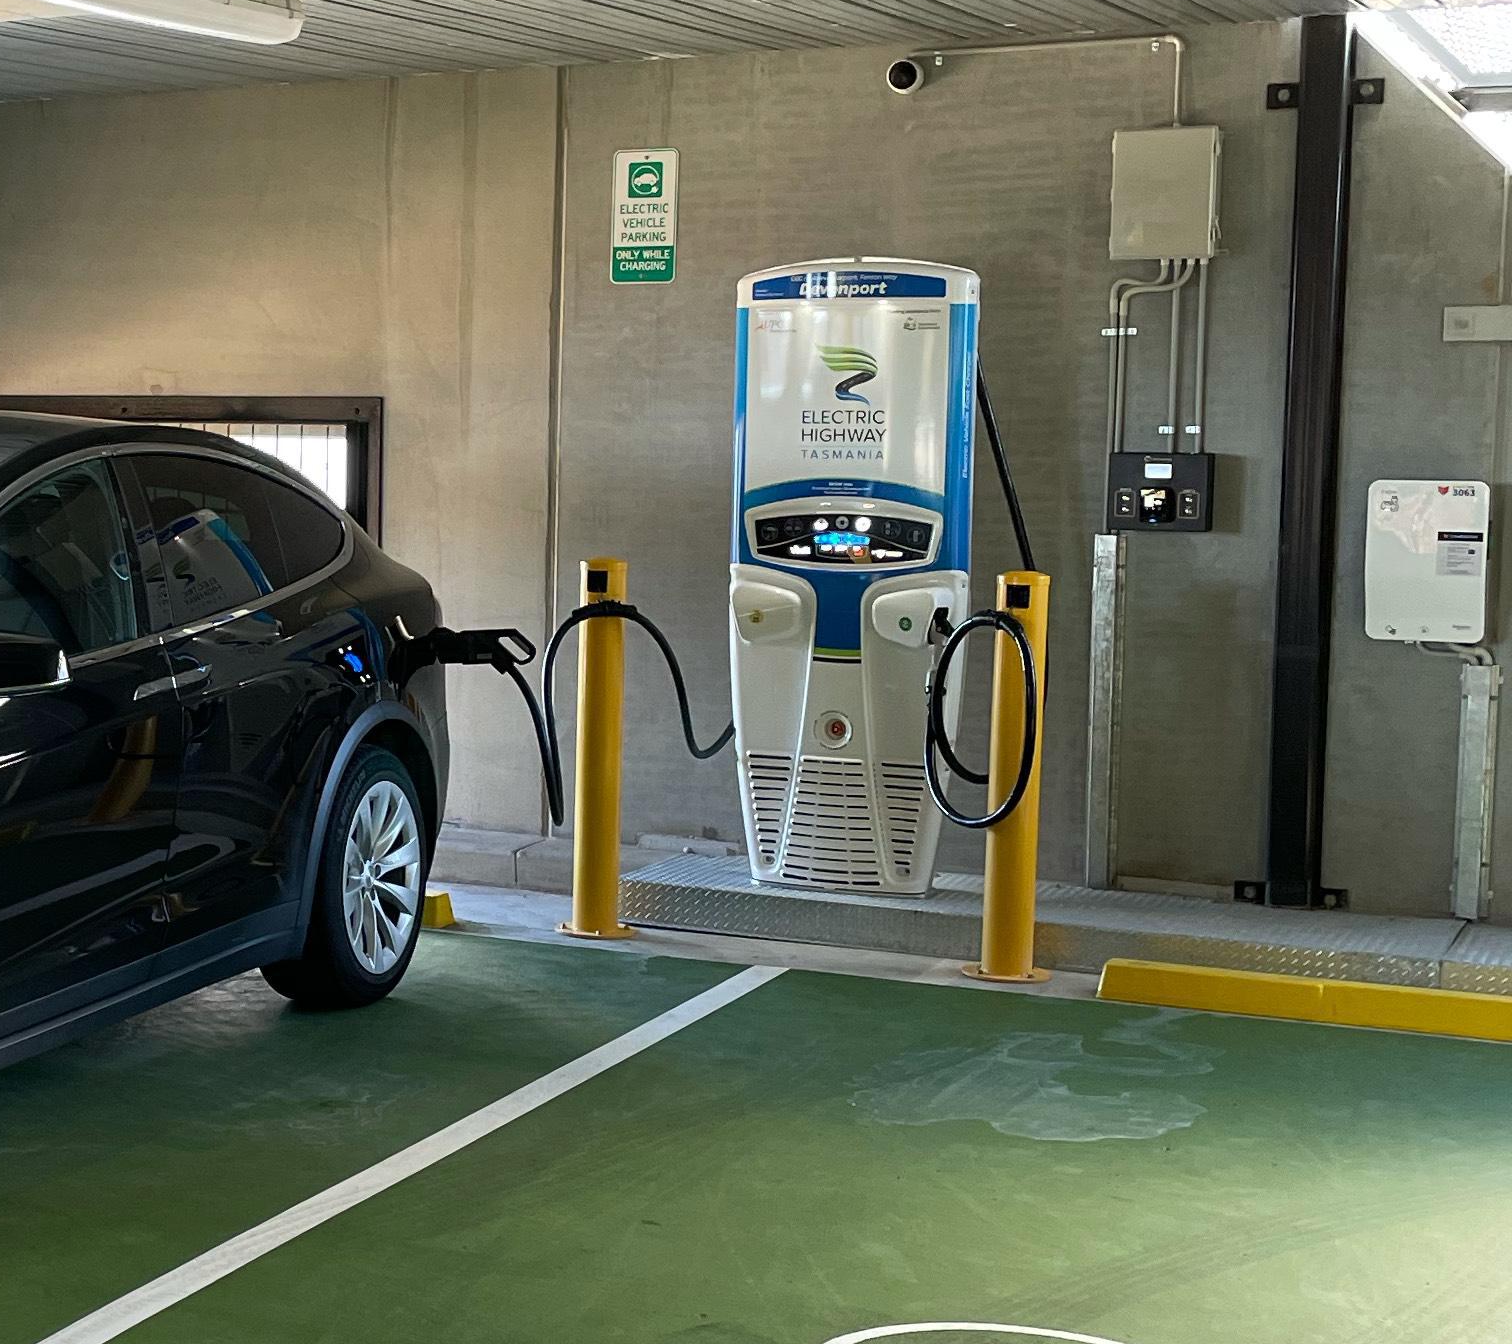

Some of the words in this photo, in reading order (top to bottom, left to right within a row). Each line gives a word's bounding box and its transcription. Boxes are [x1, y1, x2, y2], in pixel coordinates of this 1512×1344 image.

[619, 203, 669, 214] ELECTRIC
[622, 217, 666, 228] VEHICLE
[621, 232, 667, 242] PARKING
[616, 250, 640, 260] ONLY
[642, 249, 671, 259] WHILE
[619, 261, 666, 271] CHARGING
[802, 410, 885, 424] ELECTRIC
[801, 428, 887, 443] HIGHWAY
[801, 449, 884, 460] TASMANIA
